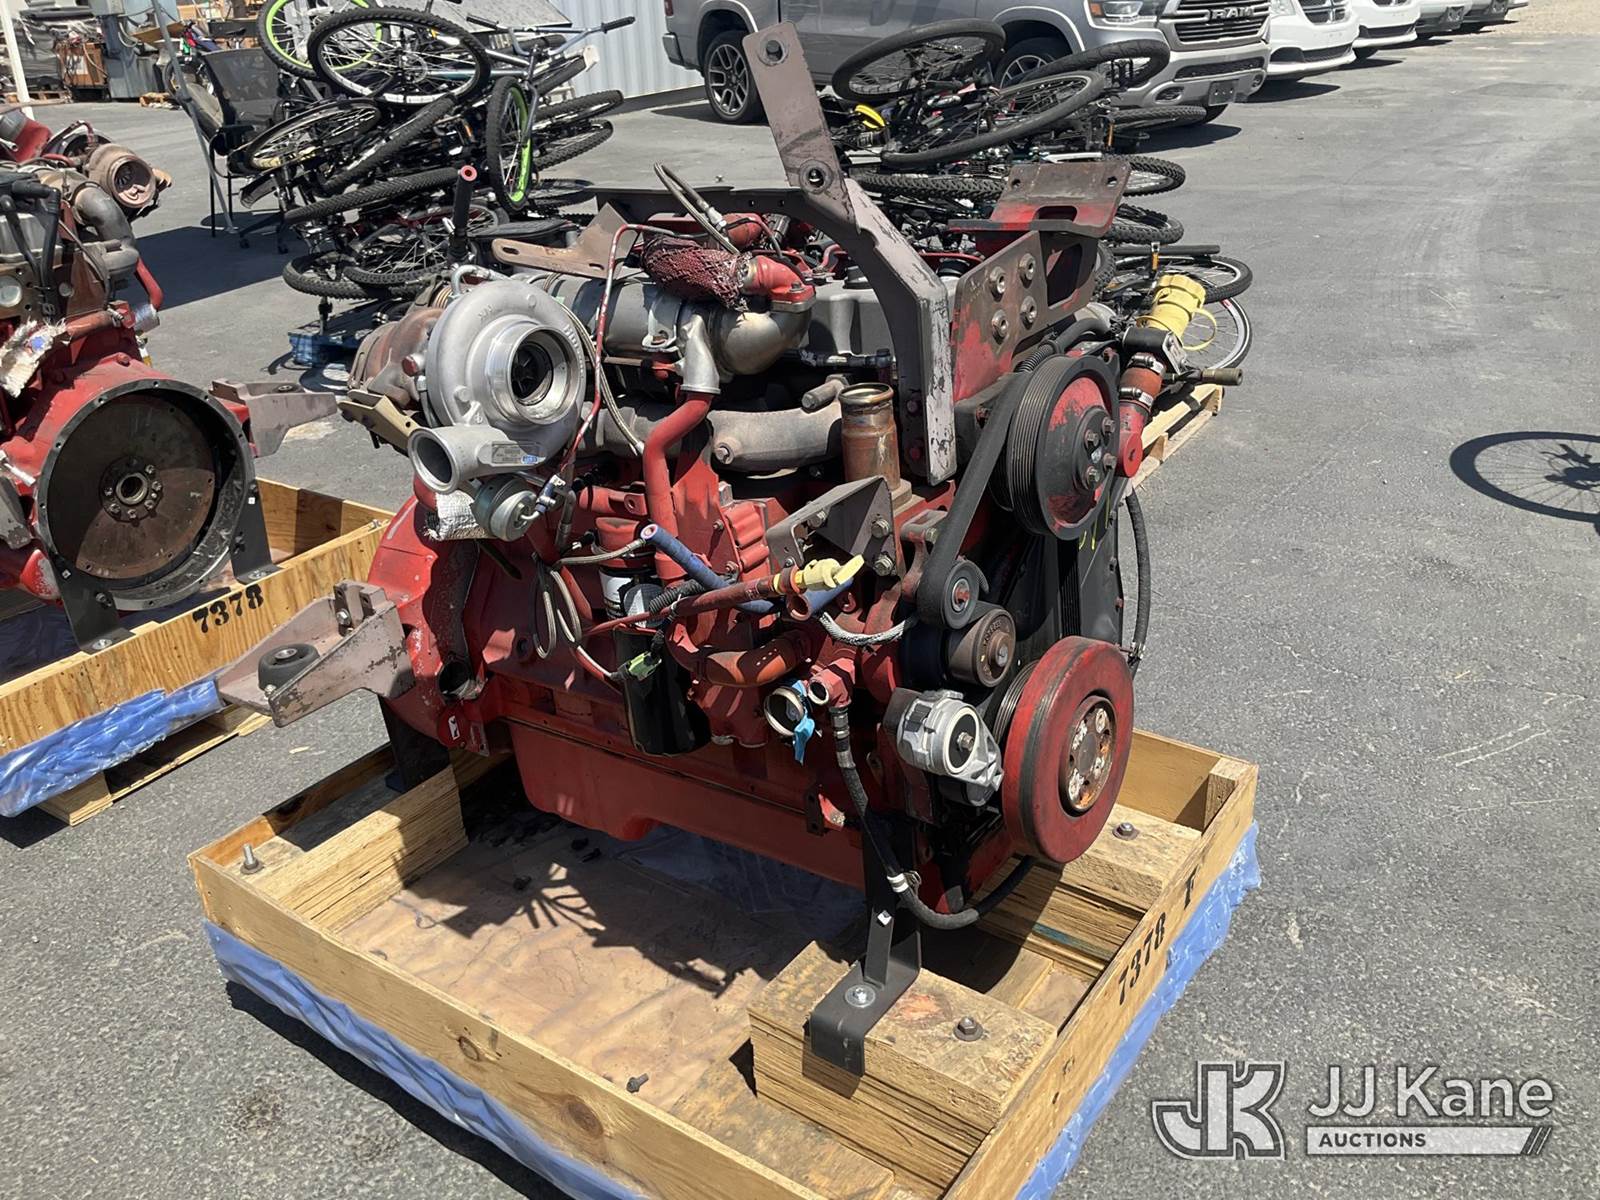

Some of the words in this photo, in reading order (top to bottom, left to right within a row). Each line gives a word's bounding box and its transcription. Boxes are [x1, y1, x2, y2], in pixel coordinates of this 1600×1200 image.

[1211, 6, 1253, 19] RAM
[192, 584, 264, 633] 7378
[1118, 912, 1166, 1005] 7378
